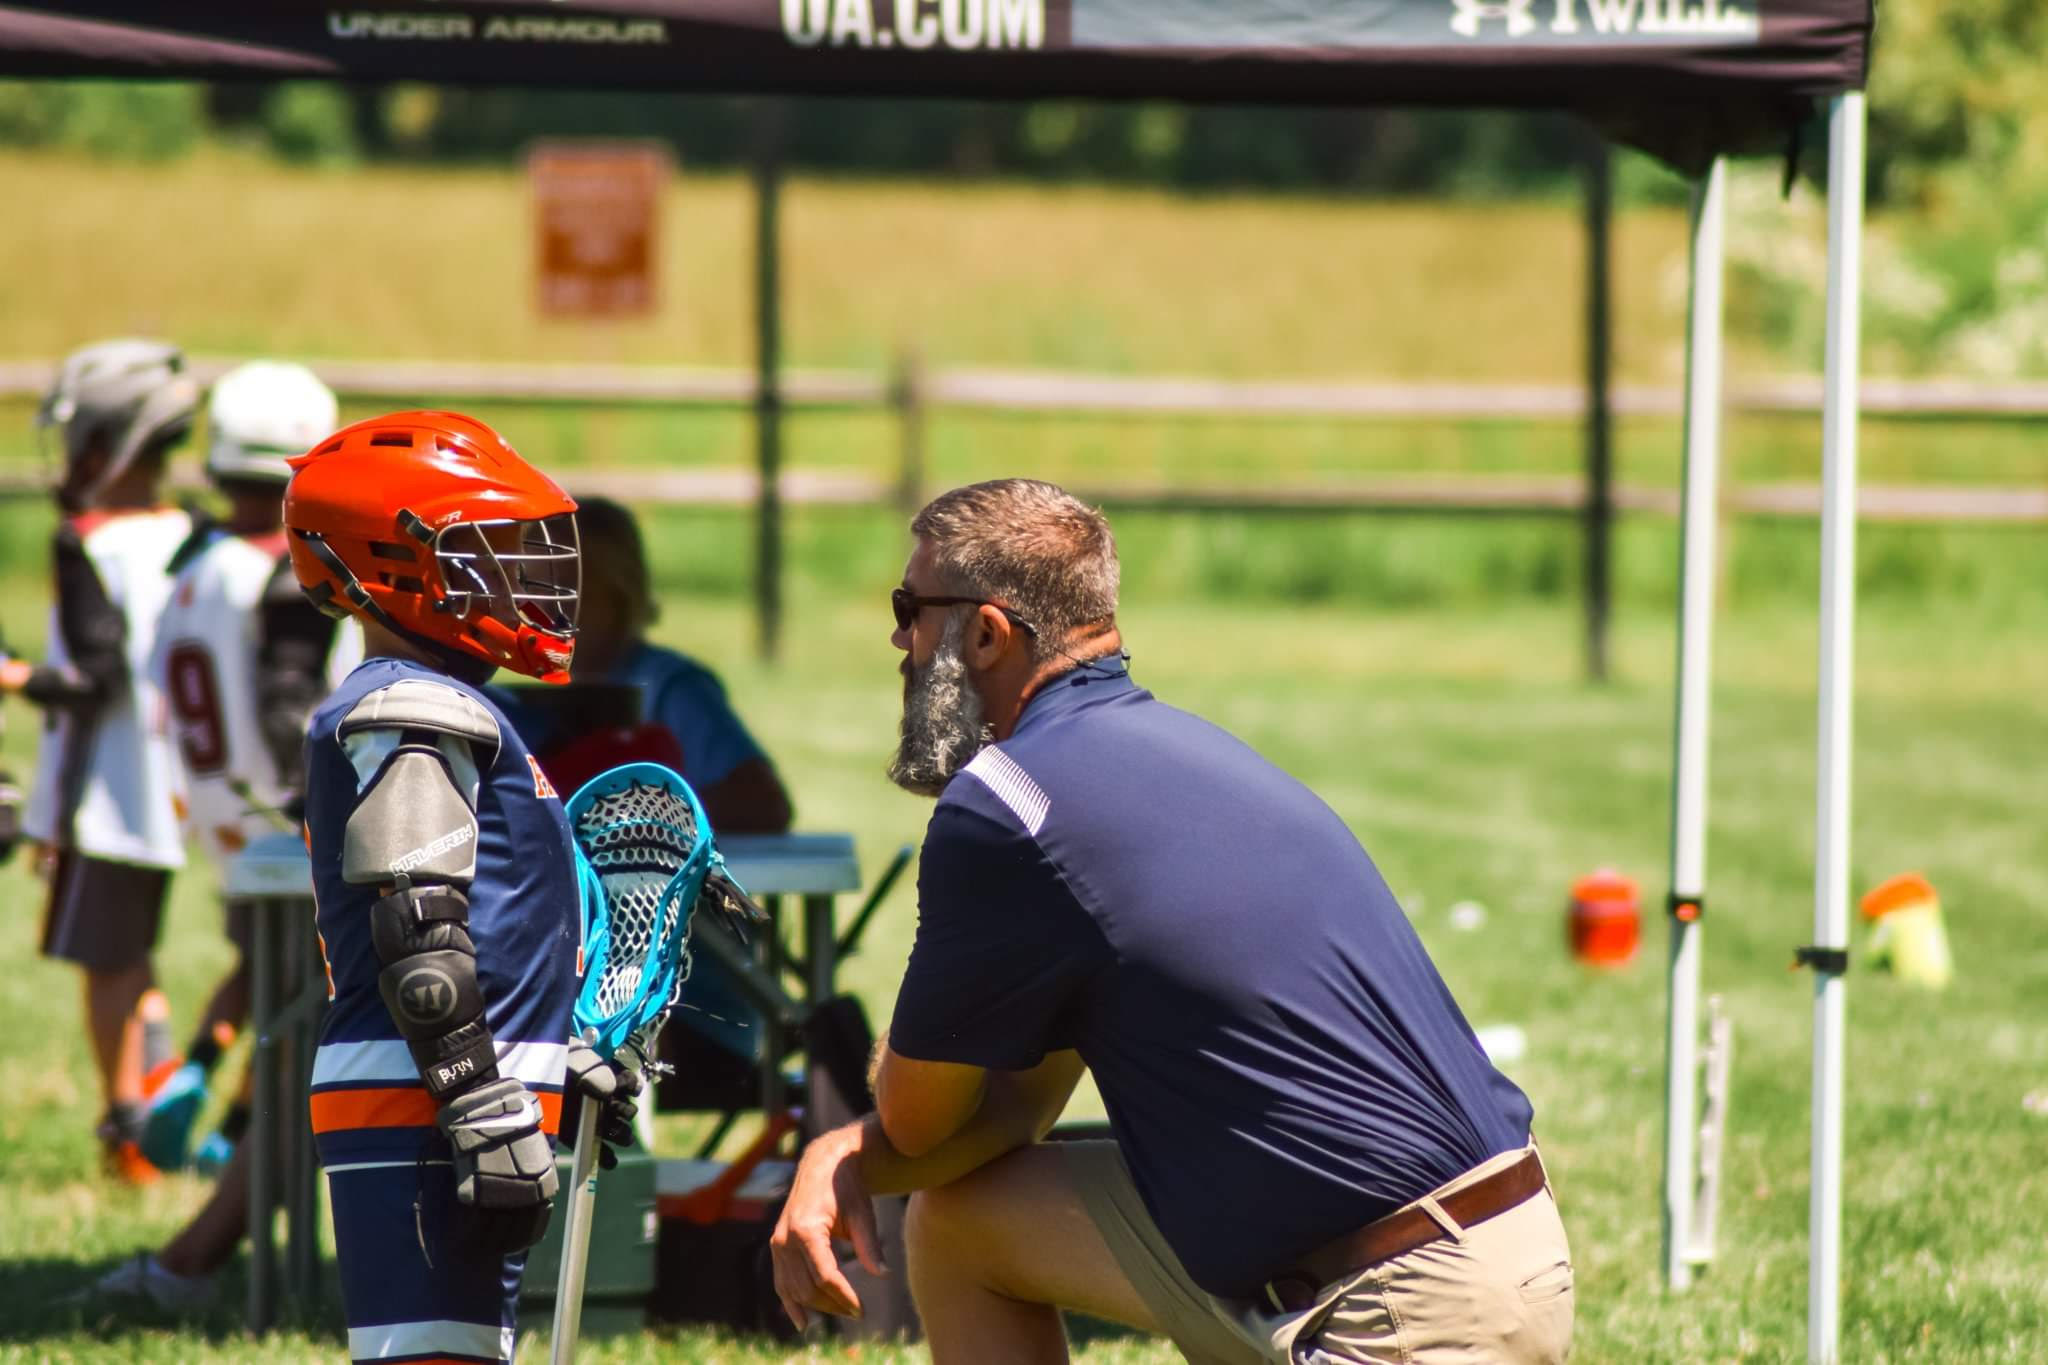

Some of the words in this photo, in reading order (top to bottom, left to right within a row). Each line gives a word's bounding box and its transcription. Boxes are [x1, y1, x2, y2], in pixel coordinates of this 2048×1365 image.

[329, 14, 472, 39] UNDER
[484, 17, 666, 43] ARMOUR
[166, 637, 230, 780] 9
[389, 823, 474, 876] MAVERIK
